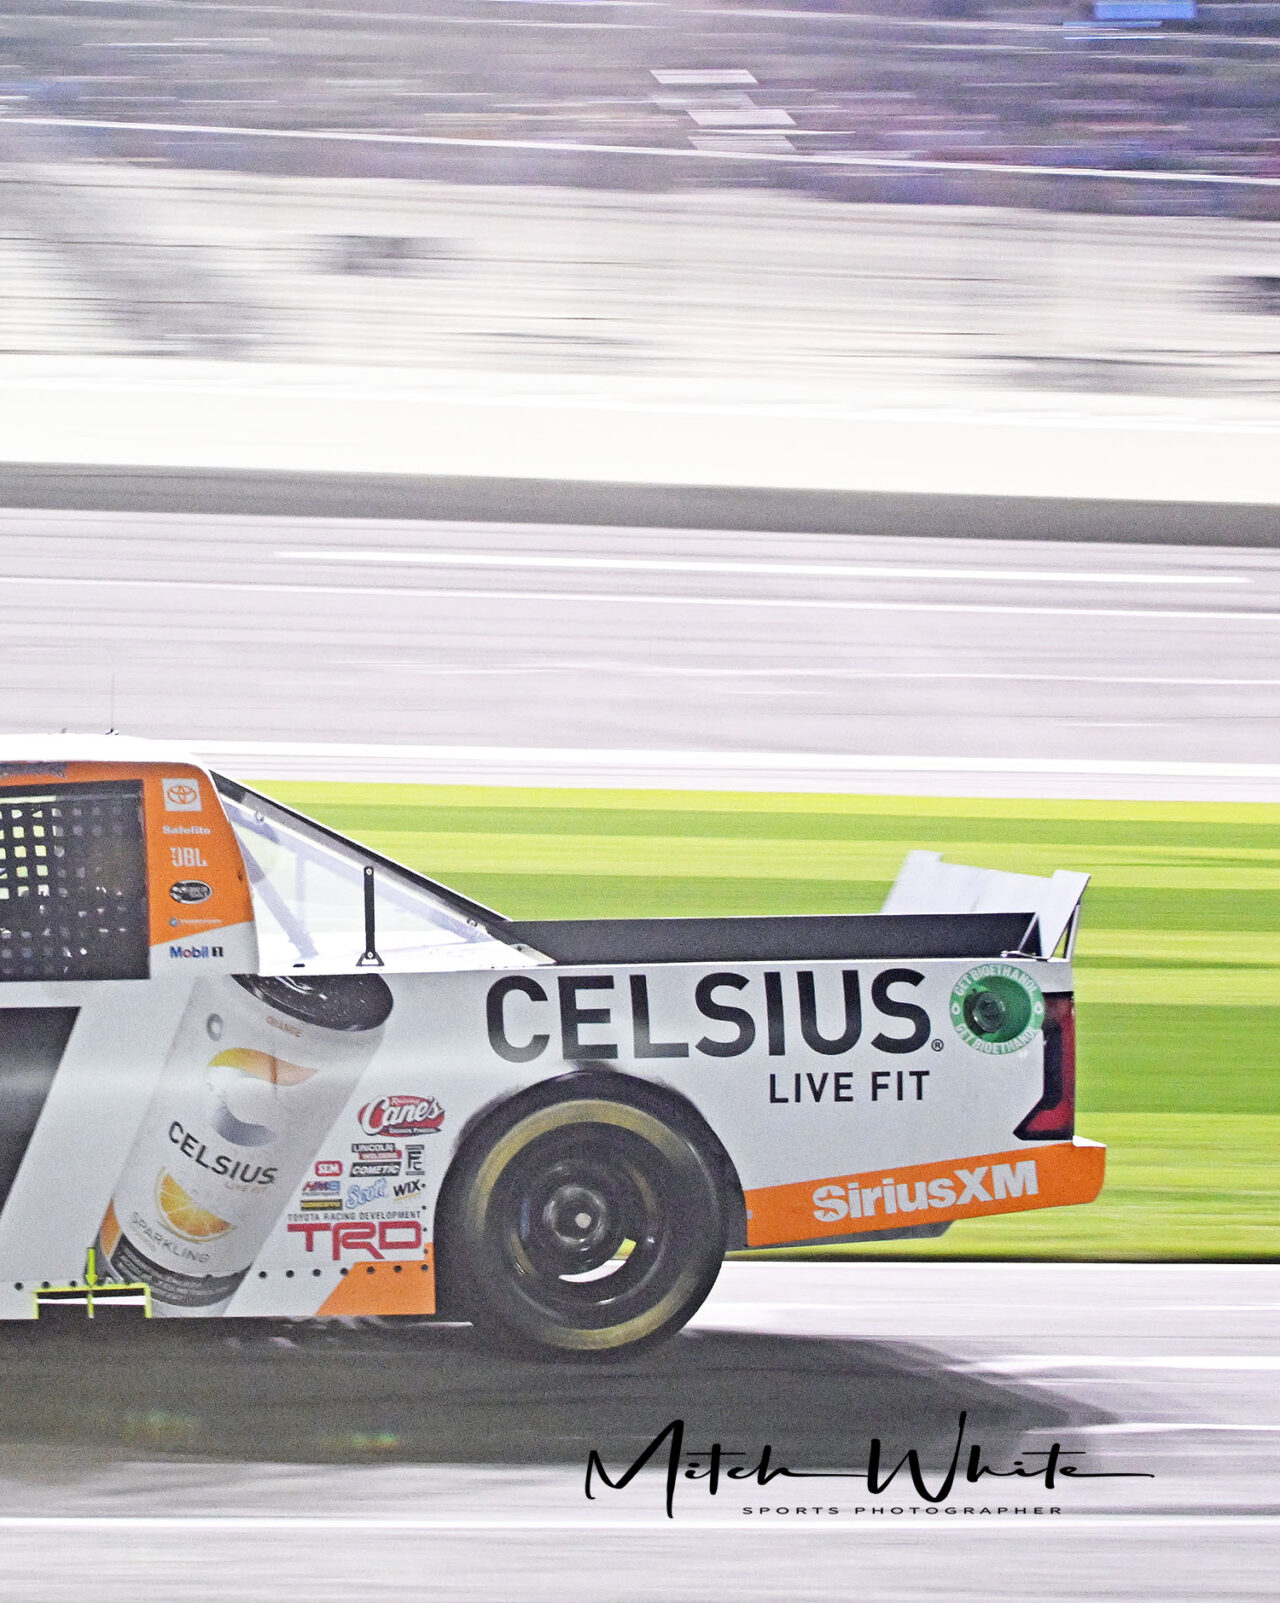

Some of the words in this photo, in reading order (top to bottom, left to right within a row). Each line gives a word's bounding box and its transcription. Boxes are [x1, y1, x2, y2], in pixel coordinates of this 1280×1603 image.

[170, 847, 208, 867] JBL
[170, 946, 209, 958] Mobil
[954, 973, 973, 997] GET
[970, 964, 1039, 995] BIOETHANOL
[770, 1072, 854, 1103] LIVE
[871, 1071, 930, 1101] FIT
[362, 1095, 444, 1136] Cane's
[168, 1121, 278, 1184] CELSIUS
[352, 1165, 401, 1175] COMETIC
[393, 1180, 421, 1197] WIX
[813, 1160, 1039, 1222] SiriusXM
[288, 1213, 320, 1221] TOYOTA
[323, 1212, 355, 1221] RACING
[359, 1210, 420, 1220] DEVELOPMENT
[131, 1211, 210, 1263] SPARKLING
[287, 1221, 422, 1260] TRD
